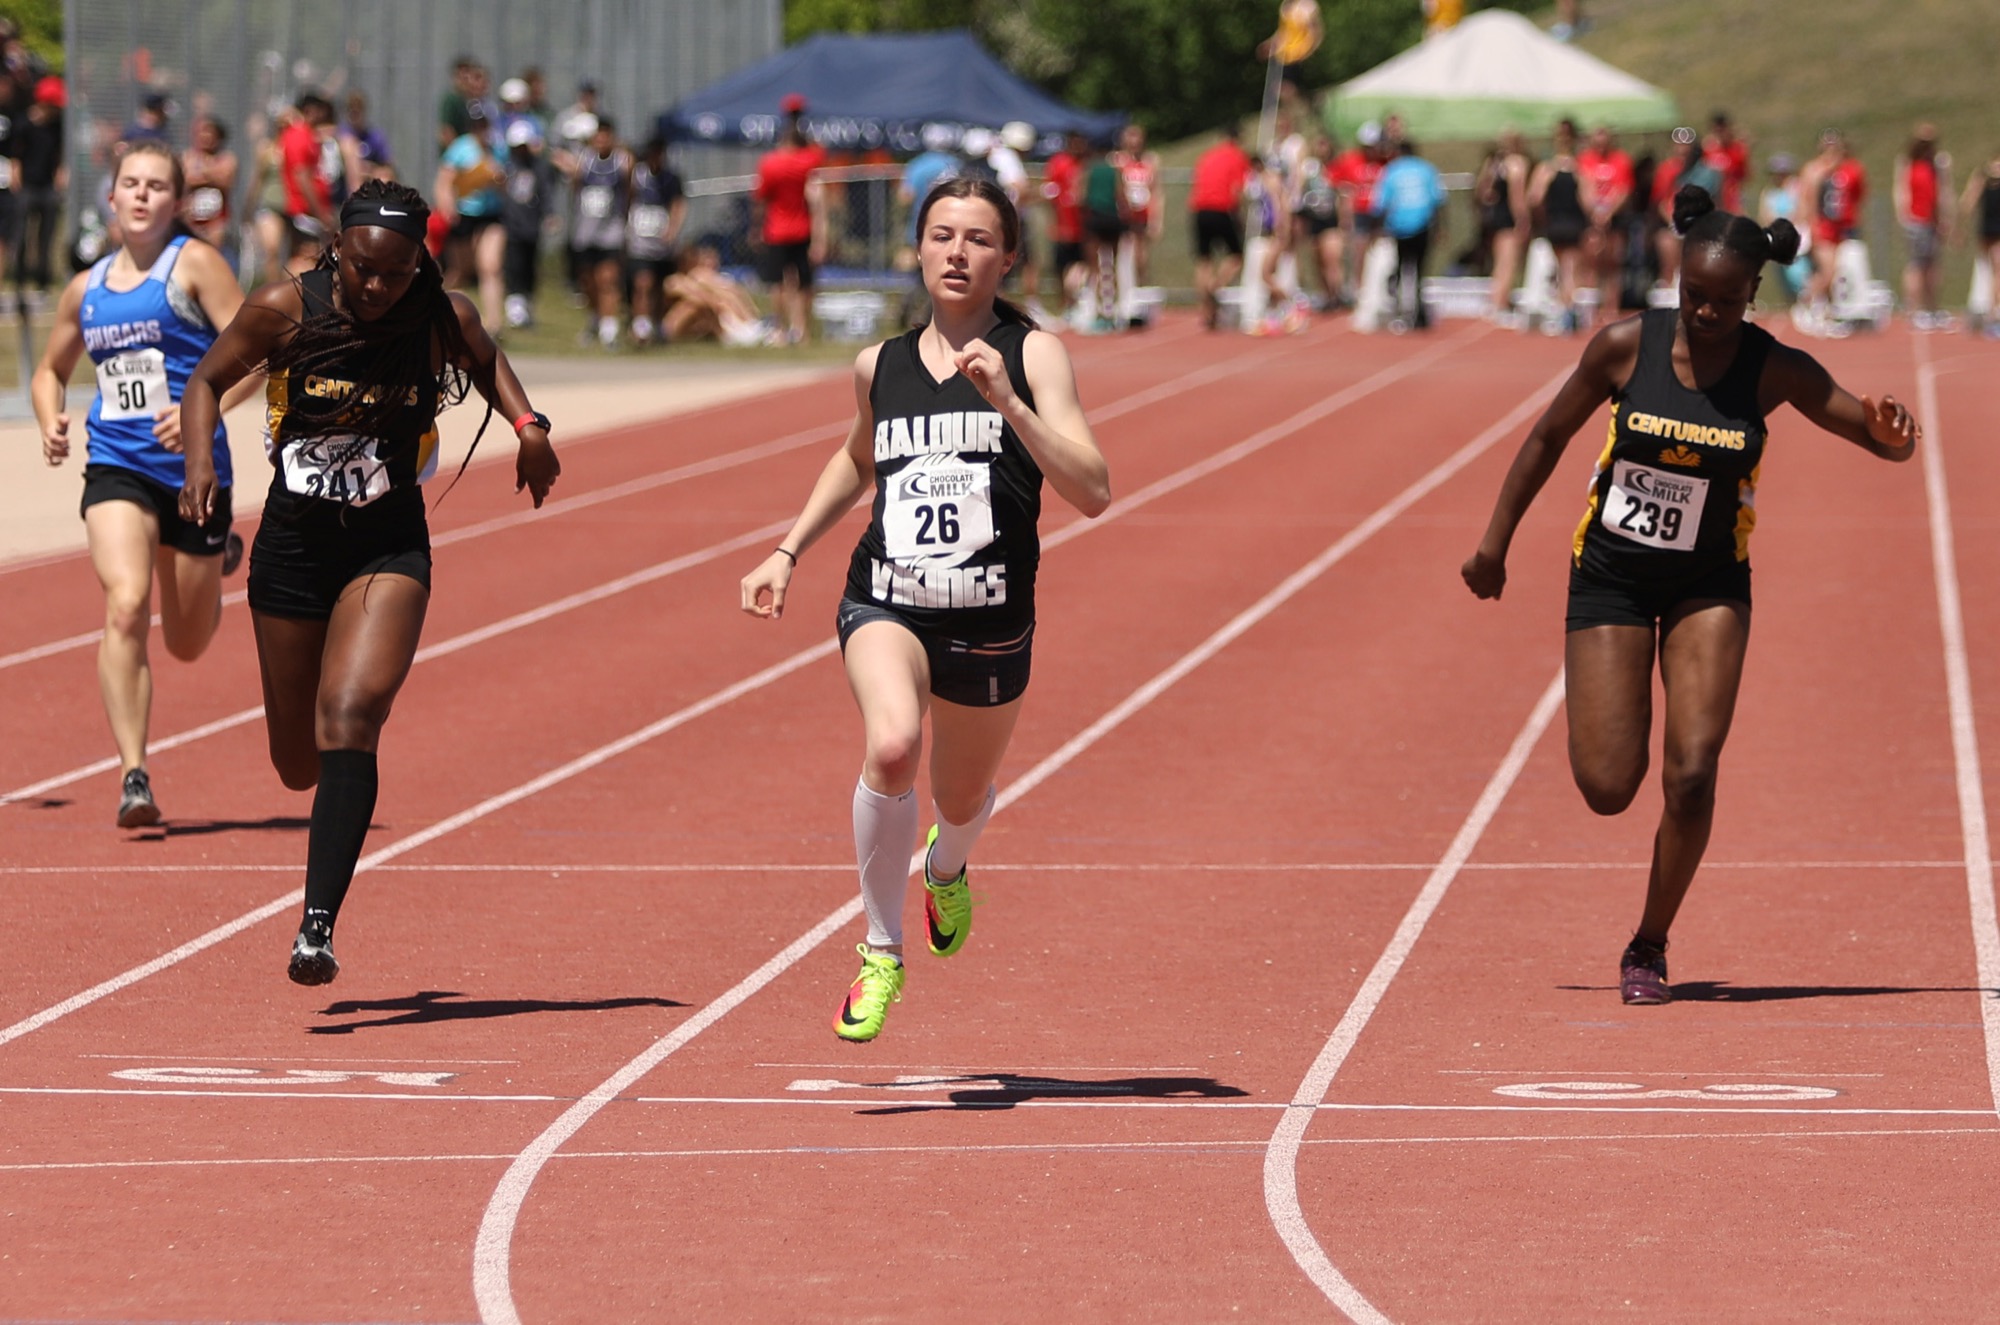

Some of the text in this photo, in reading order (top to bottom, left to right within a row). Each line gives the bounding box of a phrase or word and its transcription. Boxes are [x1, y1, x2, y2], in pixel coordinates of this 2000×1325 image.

[84, 319, 162, 351] COUGARS
[118, 380, 146, 410] 50
[874, 411, 1003, 463] BALDUR
[1627, 411, 1746, 450] CENTURIONS
[306, 466, 368, 502] 241
[930, 474, 974, 484] CHOCOLATE
[930, 482, 975, 498] MILK
[1652, 486, 1691, 505] MILK
[915, 503, 960, 545] 26
[1619, 495, 1683, 541] 239
[871, 557, 1006, 608] VIKINGS
